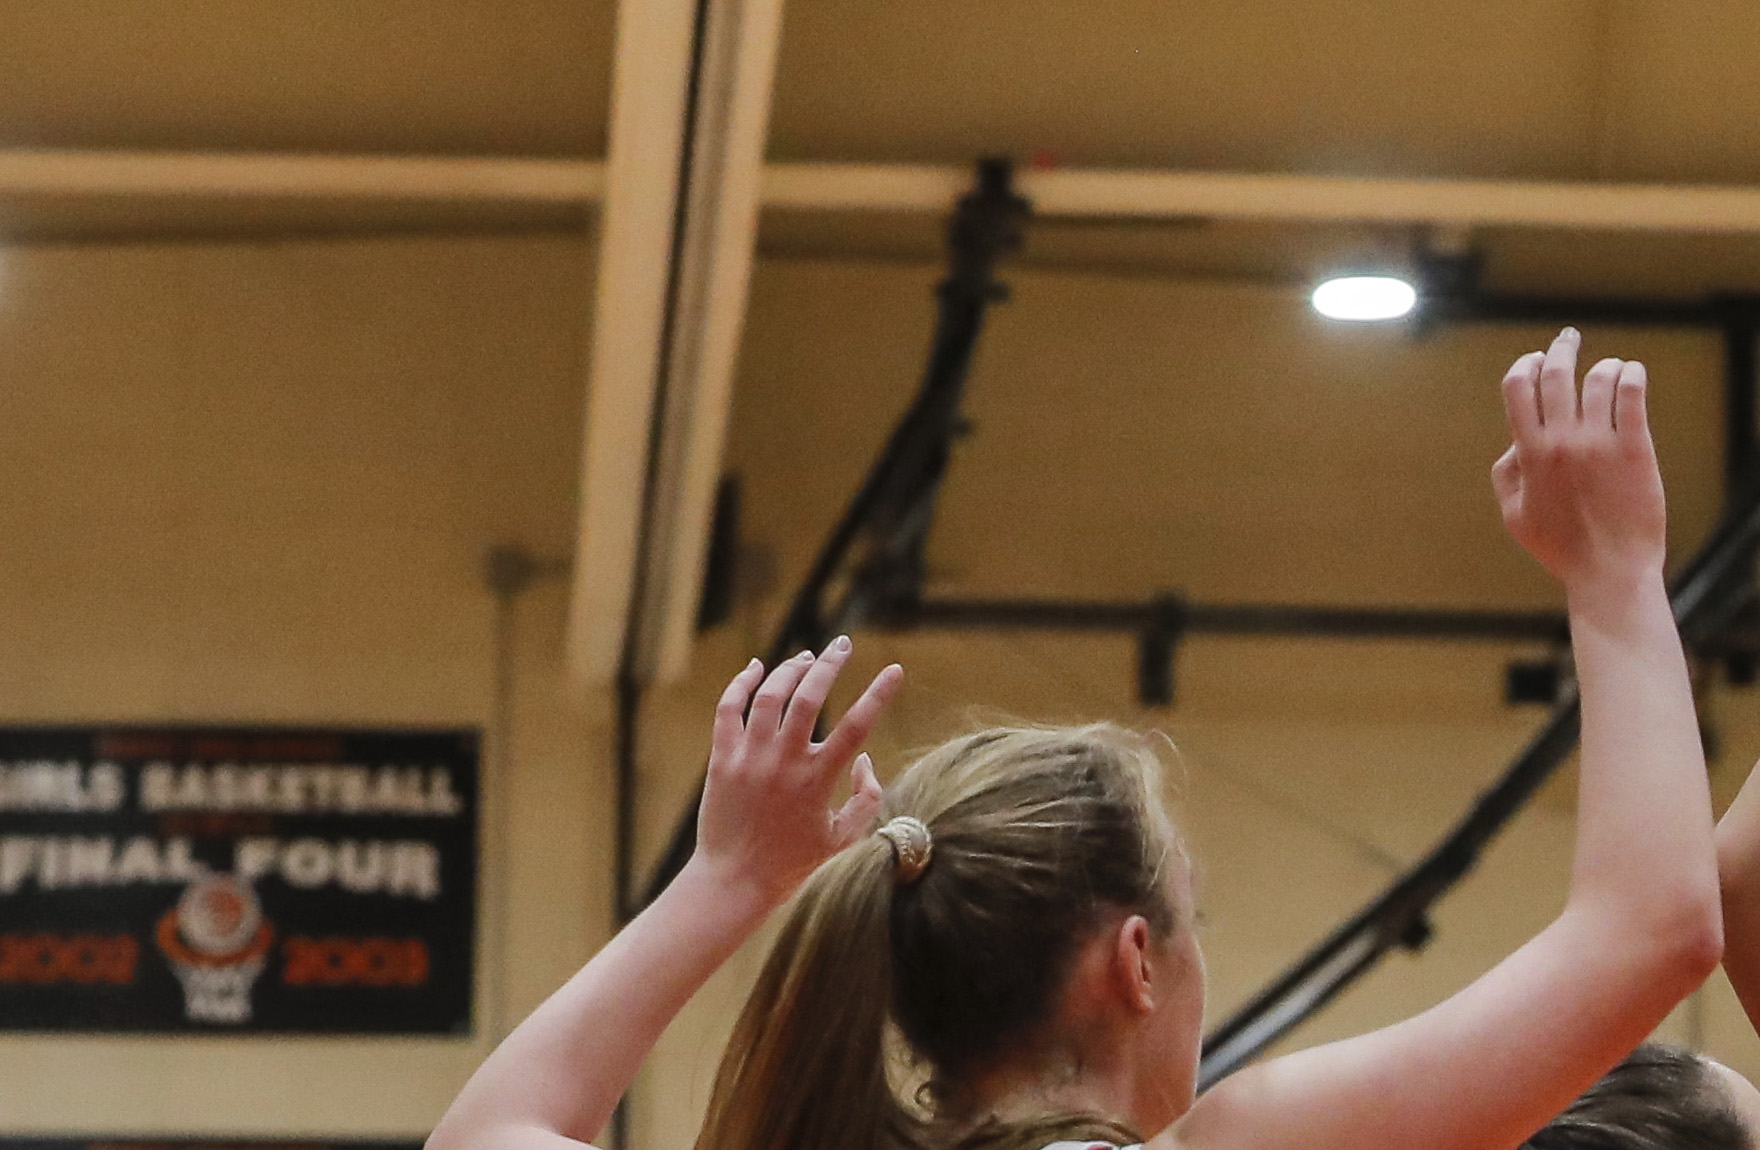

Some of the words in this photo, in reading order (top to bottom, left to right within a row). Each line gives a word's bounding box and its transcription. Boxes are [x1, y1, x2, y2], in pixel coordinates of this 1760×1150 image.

[139, 762, 462, 816] BASKETBALL
[0, 838, 198, 893] FINAL
[234, 840, 441, 899] FOUR
